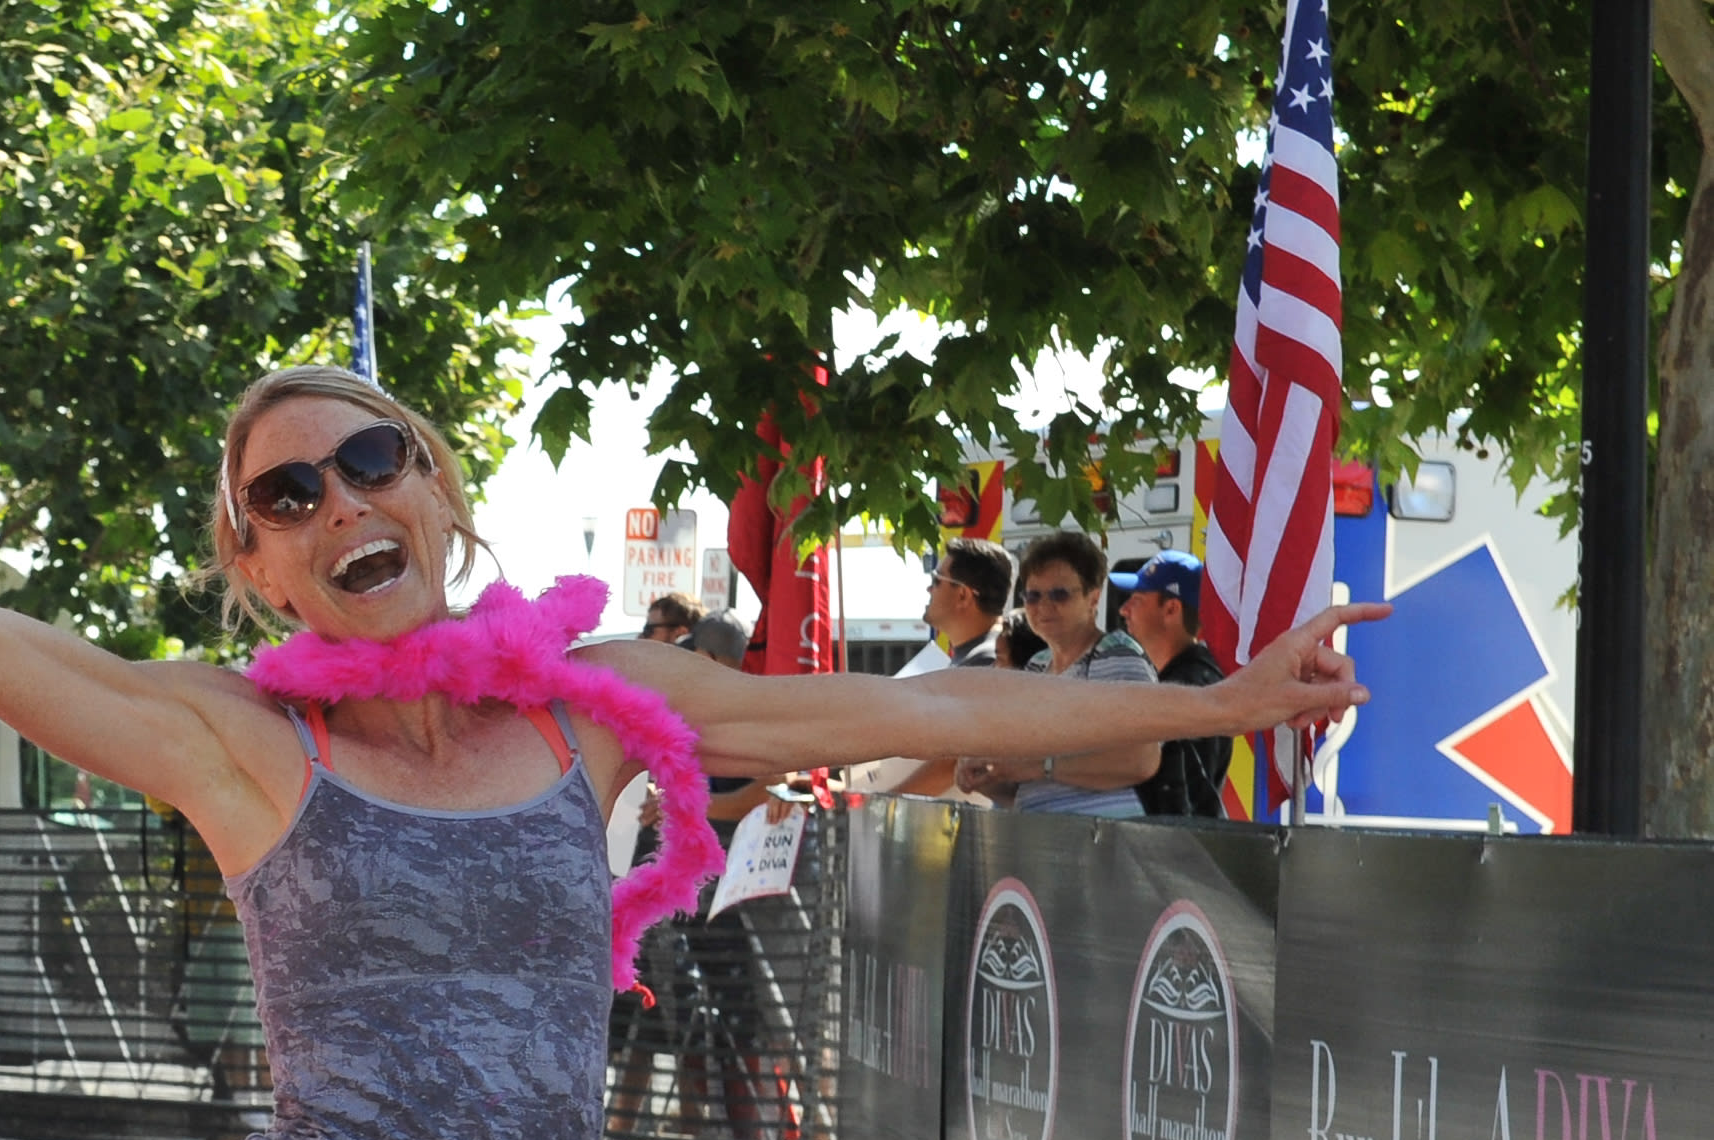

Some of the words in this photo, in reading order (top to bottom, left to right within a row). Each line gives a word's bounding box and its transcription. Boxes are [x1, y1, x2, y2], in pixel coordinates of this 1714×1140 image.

[629, 512, 655, 537] NO
[628, 547, 691, 567] PARKING
[643, 571, 676, 587] FIRE
[764, 834, 793, 848] RUN
[759, 859, 787, 871] DIVA
[983, 988, 1036, 1057] DIVAS
[1149, 1018, 1214, 1094] DIVAS
[992, 1060, 1049, 1112] marathon
